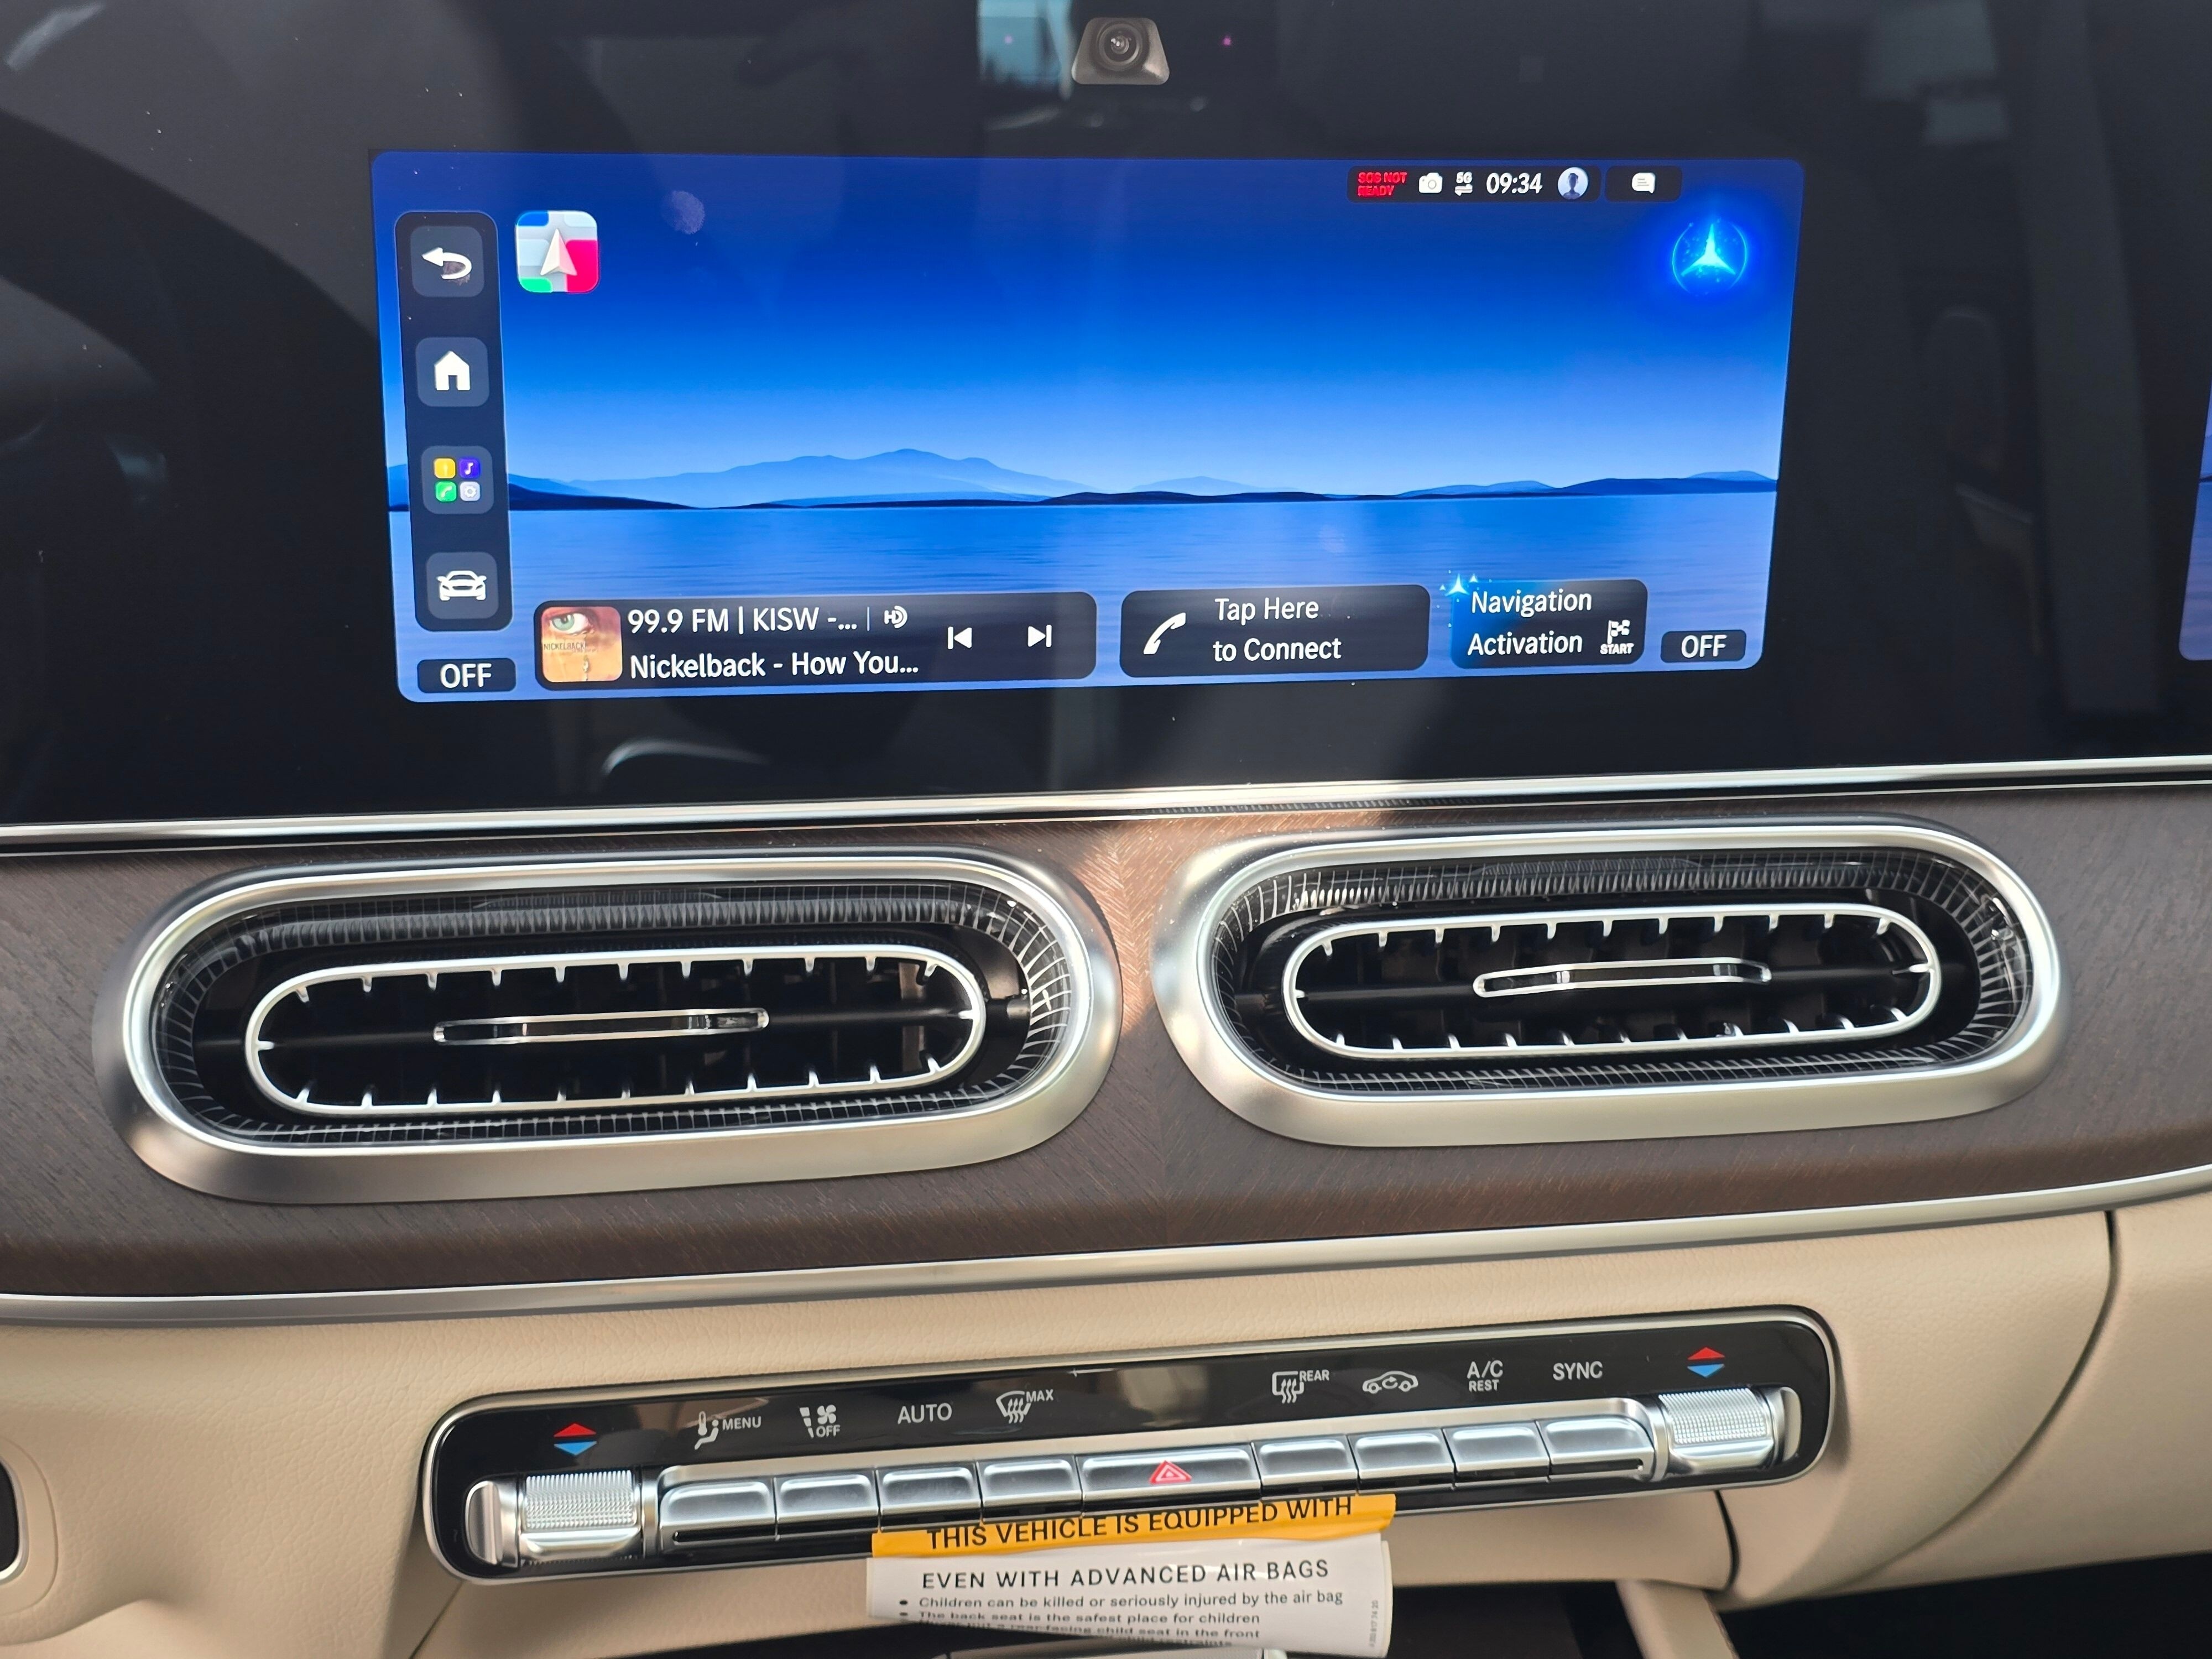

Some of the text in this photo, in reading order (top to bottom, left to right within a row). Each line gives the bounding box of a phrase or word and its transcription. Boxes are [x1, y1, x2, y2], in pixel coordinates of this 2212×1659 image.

[1384, 171, 1407, 184] NOT
[1486, 172, 1543, 194] 09:34
[1358, 185, 1395, 196] READY
[1214, 597, 1319, 625] Tap Here
[1471, 588, 1592, 618] Navigation
[628, 609, 683, 634] 99.9
[692, 608, 729, 633] FM
[753, 607, 820, 632] KISW
[1213, 638, 1342, 662] to Connect
[1467, 630, 1583, 656] Activation
[1600, 643, 1635, 655] START
[1680, 634, 1727, 658] OFF
[630, 651, 766, 679] Nickelback
[791, 651, 847, 676] How
[439, 664, 493, 688] OFF
[1299, 1369, 1330, 1383] REAR
[1467, 1360, 1504, 1379] A/C
[1552, 1360, 1604, 1381] SYNC
[1026, 1389, 1054, 1403] MAX
[1469, 1379, 1498, 1392] REST
[722, 1416, 762, 1431] MENU
[897, 1402, 952, 1425] AUTO
[816, 1423, 841, 1437] OFF
[927, 1495, 1352, 1549] THIS VEHICLE IS EQUIPPED WITH
[922, 1558, 1329, 1589] EVEN WITH ADVANCED AIR BAGS
[919, 1589, 1343, 1609] Children can be killed or seriously injured by the air bag
[919, 1611, 1260, 1625] The back seat is the safest place for children
[1097, 1626, 1133, 1634] child
[1176, 1627, 1190, 1637] in
[1195, 1628, 1218, 1637] the
[1224, 1629, 1259, 1639] front
